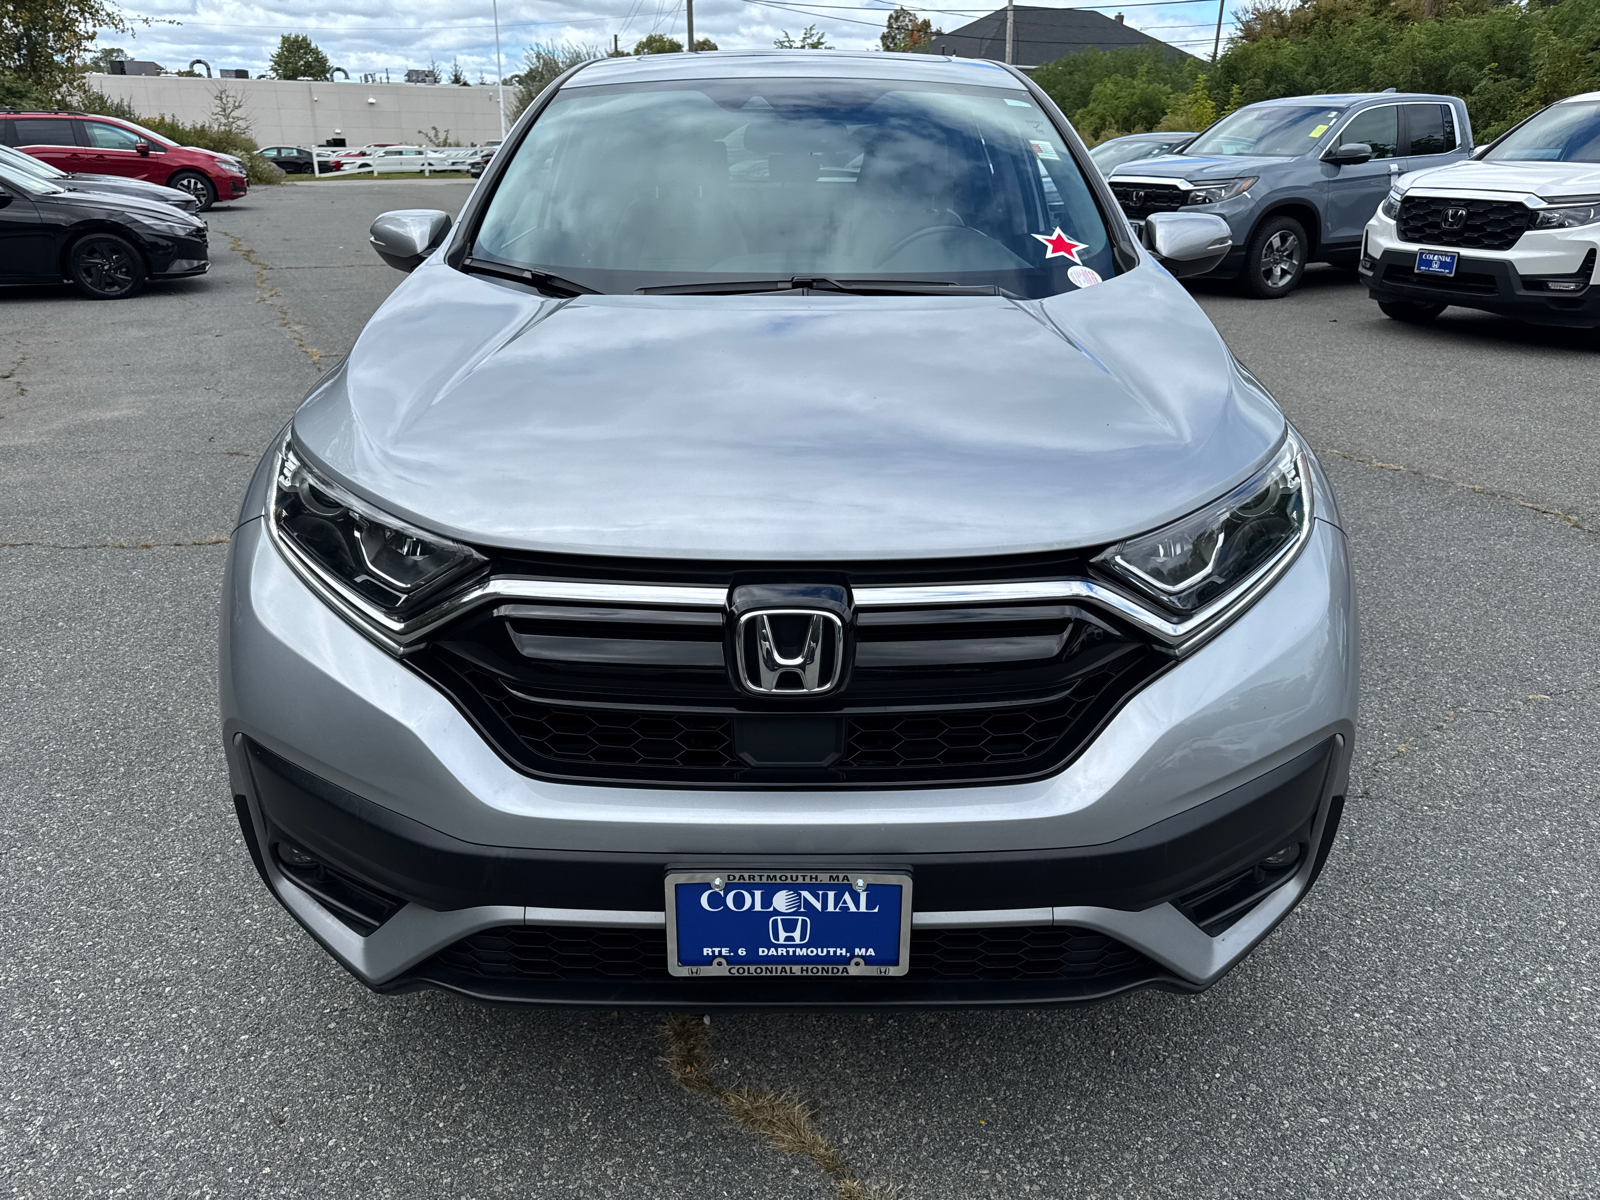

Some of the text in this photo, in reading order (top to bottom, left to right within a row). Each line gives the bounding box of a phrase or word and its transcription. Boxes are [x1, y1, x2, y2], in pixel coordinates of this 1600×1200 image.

[726, 874, 851, 883] DARTMOUTH, MA
[700, 889, 880, 913] COLONIAL
[702, 947, 876, 957] RTE. 6 DARTMOUTH, MA
[727, 966, 850, 975] COLONIAL HONDA
